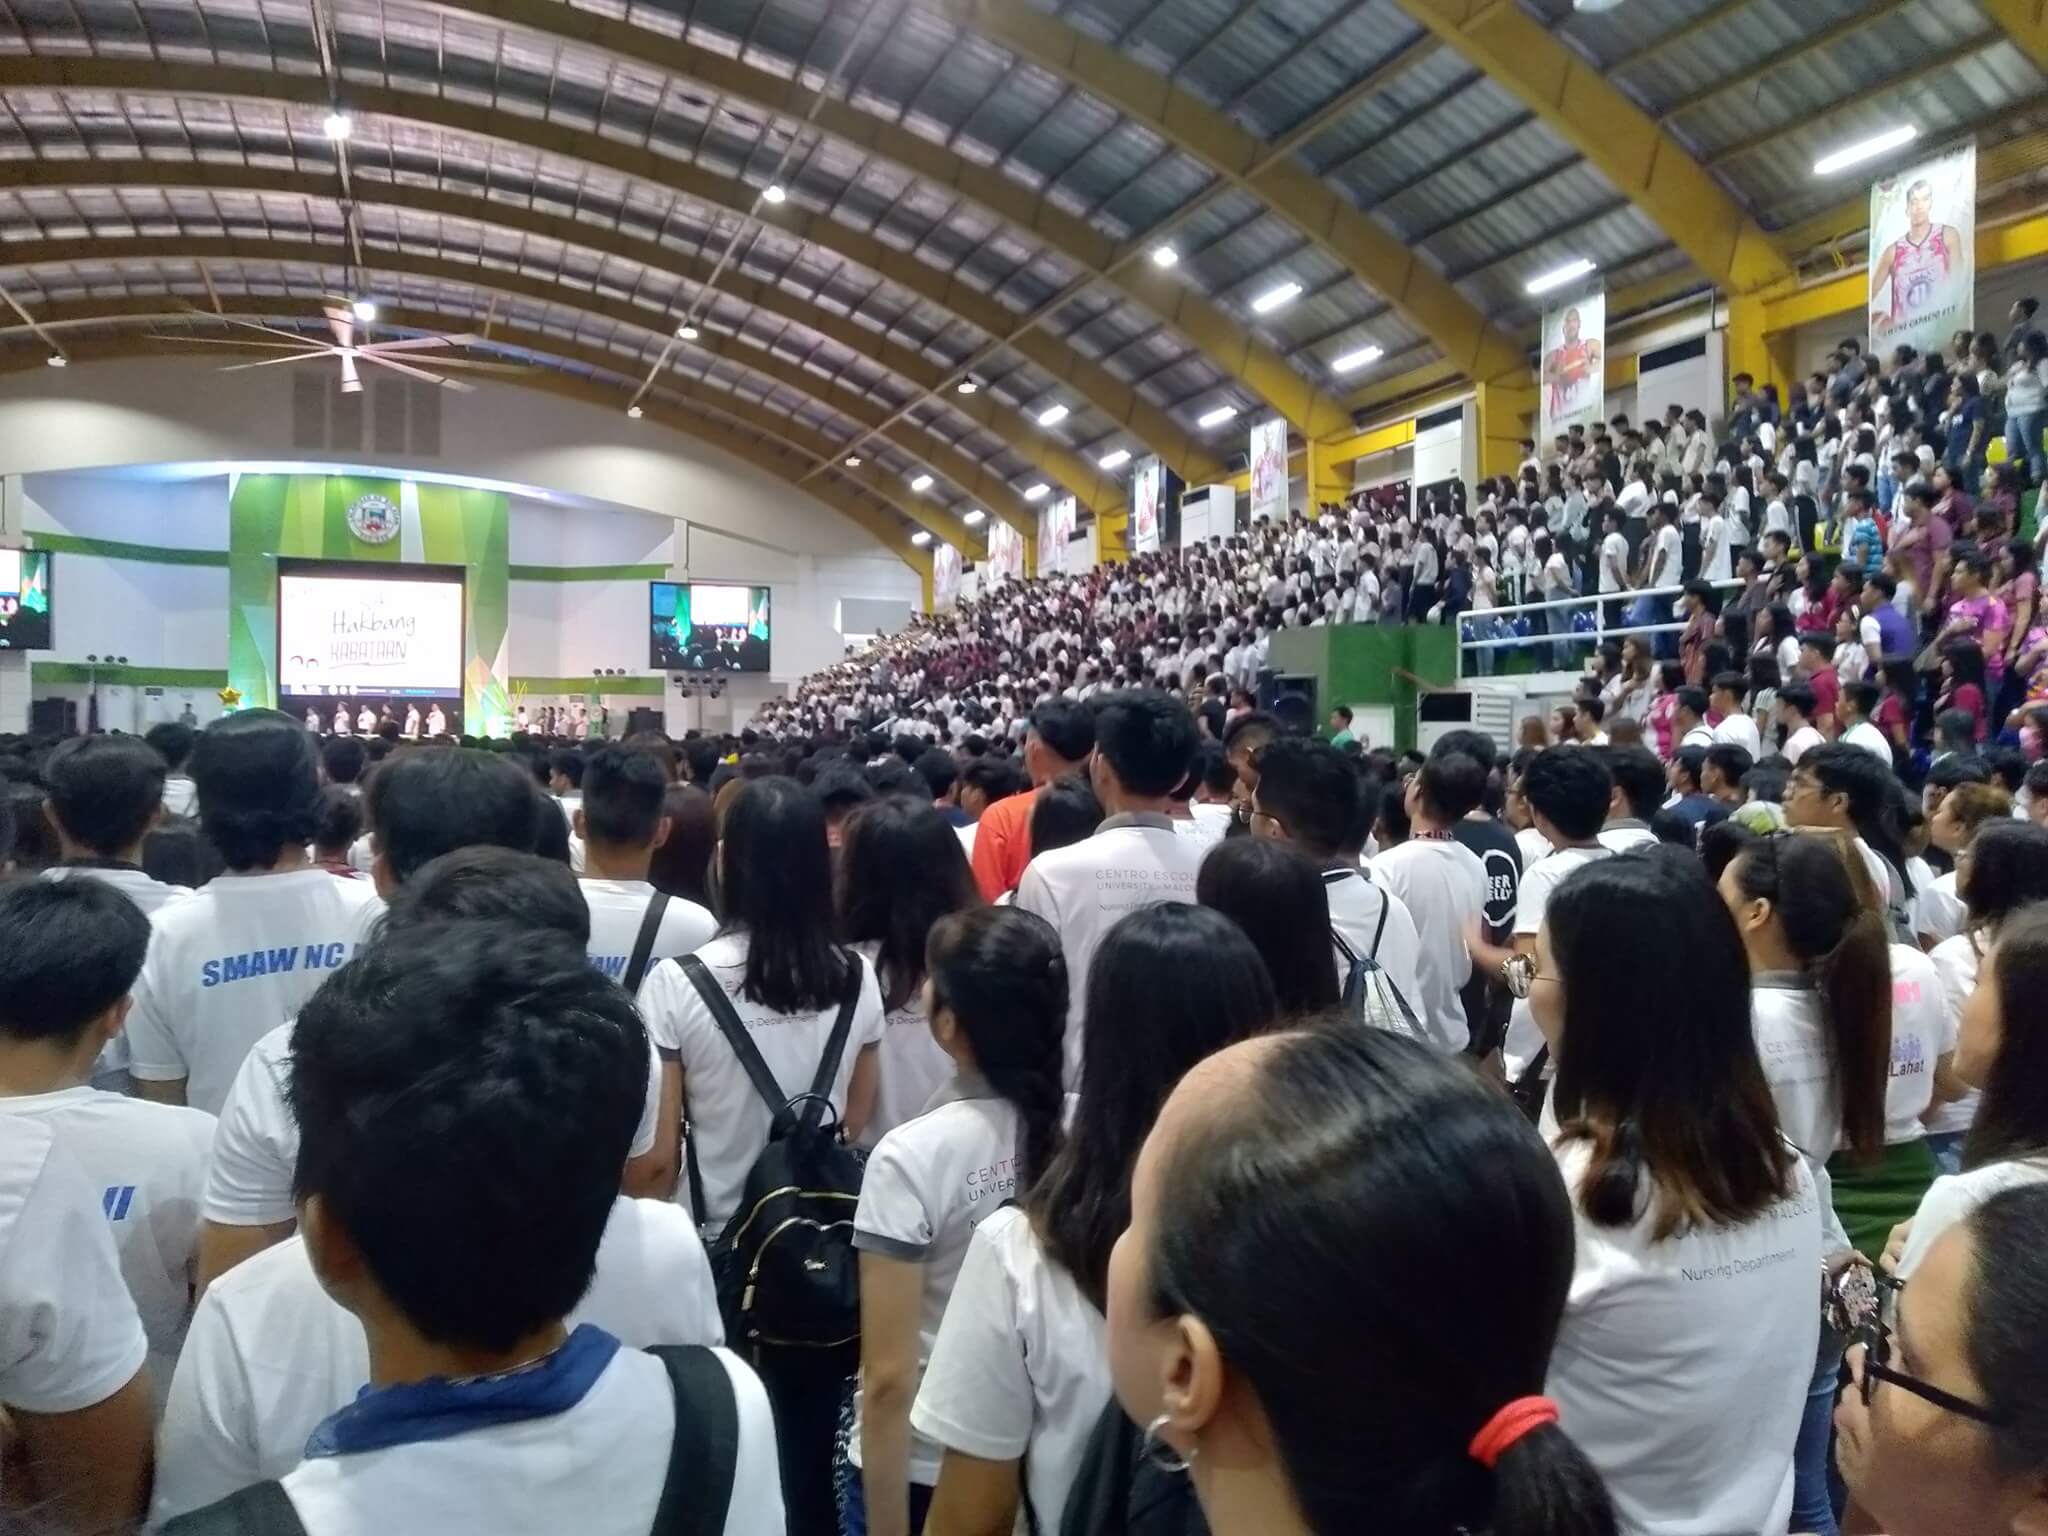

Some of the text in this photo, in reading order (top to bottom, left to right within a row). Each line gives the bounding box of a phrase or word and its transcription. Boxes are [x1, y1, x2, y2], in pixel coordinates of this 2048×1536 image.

[332, 610, 416, 637] Hakbang
[330, 641, 407, 662] KABATAAN
[1095, 869, 1195, 881] CENTRO ESCOL
[1489, 874, 1511, 889] EER
[1163, 883, 1195, 892] MALO
[1489, 886, 1513, 901] ELLY
[201, 941, 346, 987] SMAW NC
[1889, 1059, 1925, 1077] Lahat
[1681, 1247, 1796, 1281] Nursing Department
